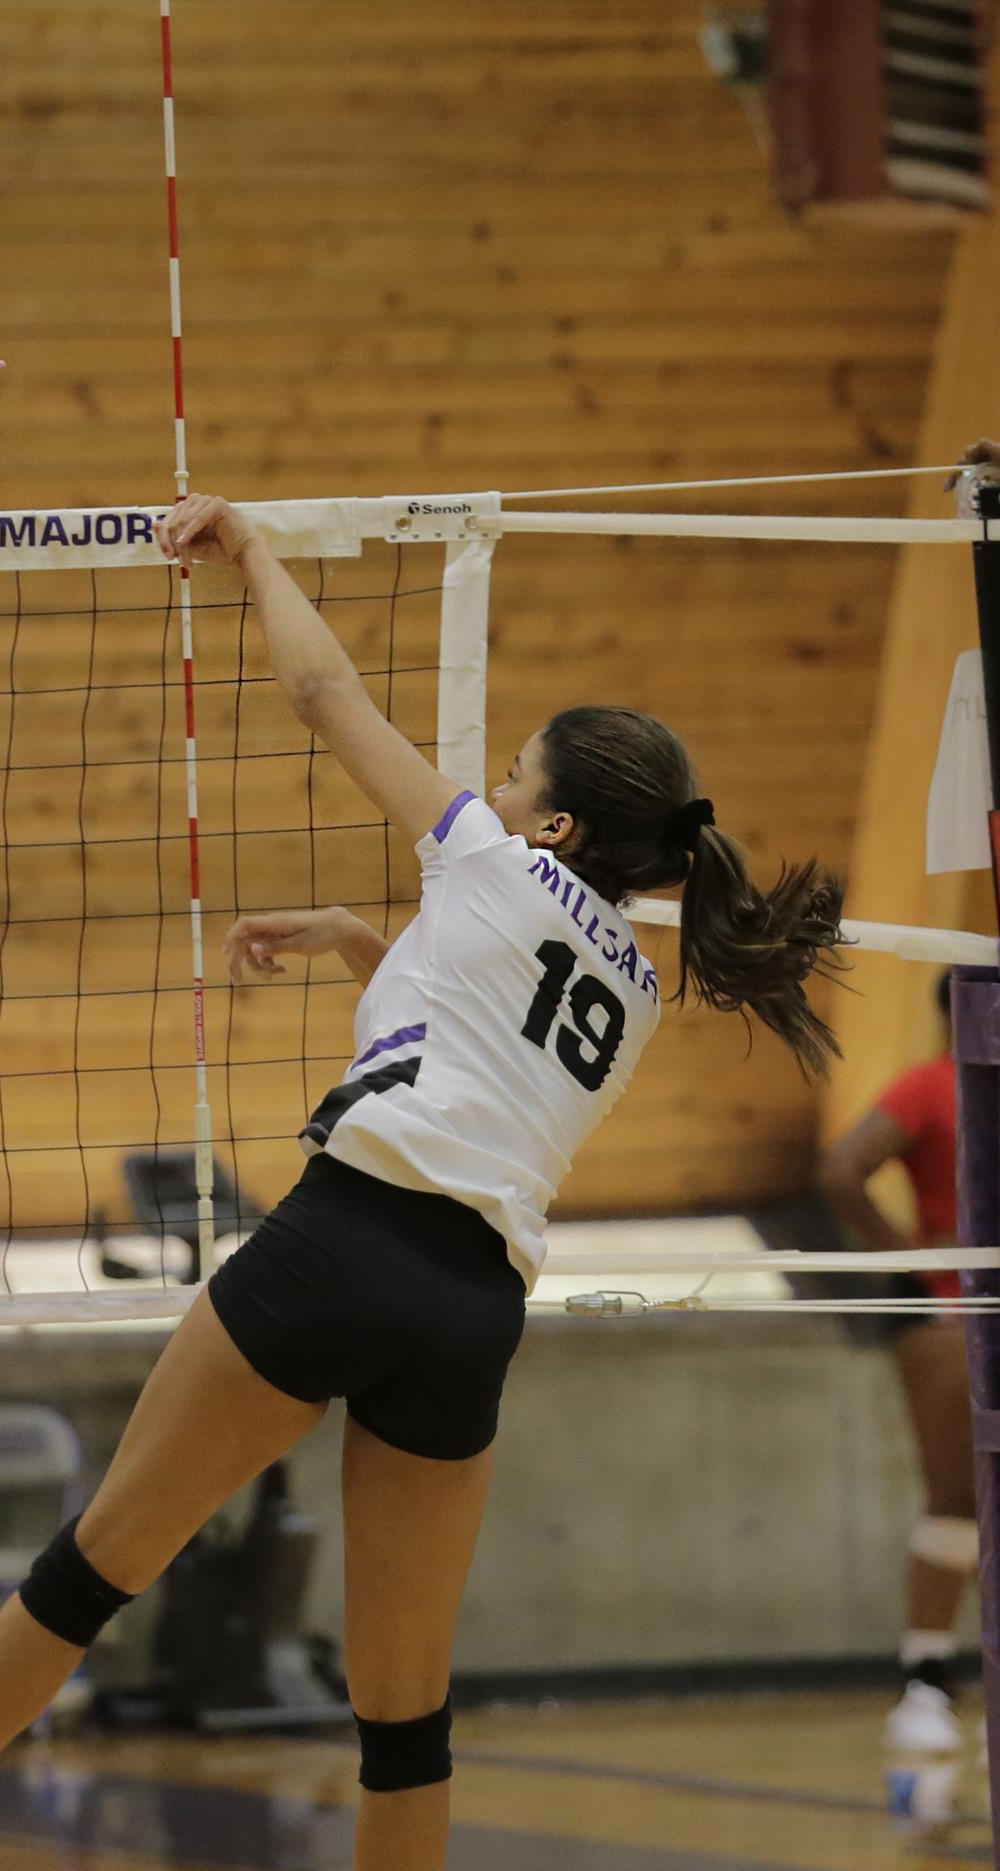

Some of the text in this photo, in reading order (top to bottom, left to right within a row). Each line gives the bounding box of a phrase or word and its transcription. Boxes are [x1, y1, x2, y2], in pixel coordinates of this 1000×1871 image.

[422, 503, 472, 515] Senoh
[0, 513, 166, 548] MAJOR
[520, 938, 626, 1092] 19
